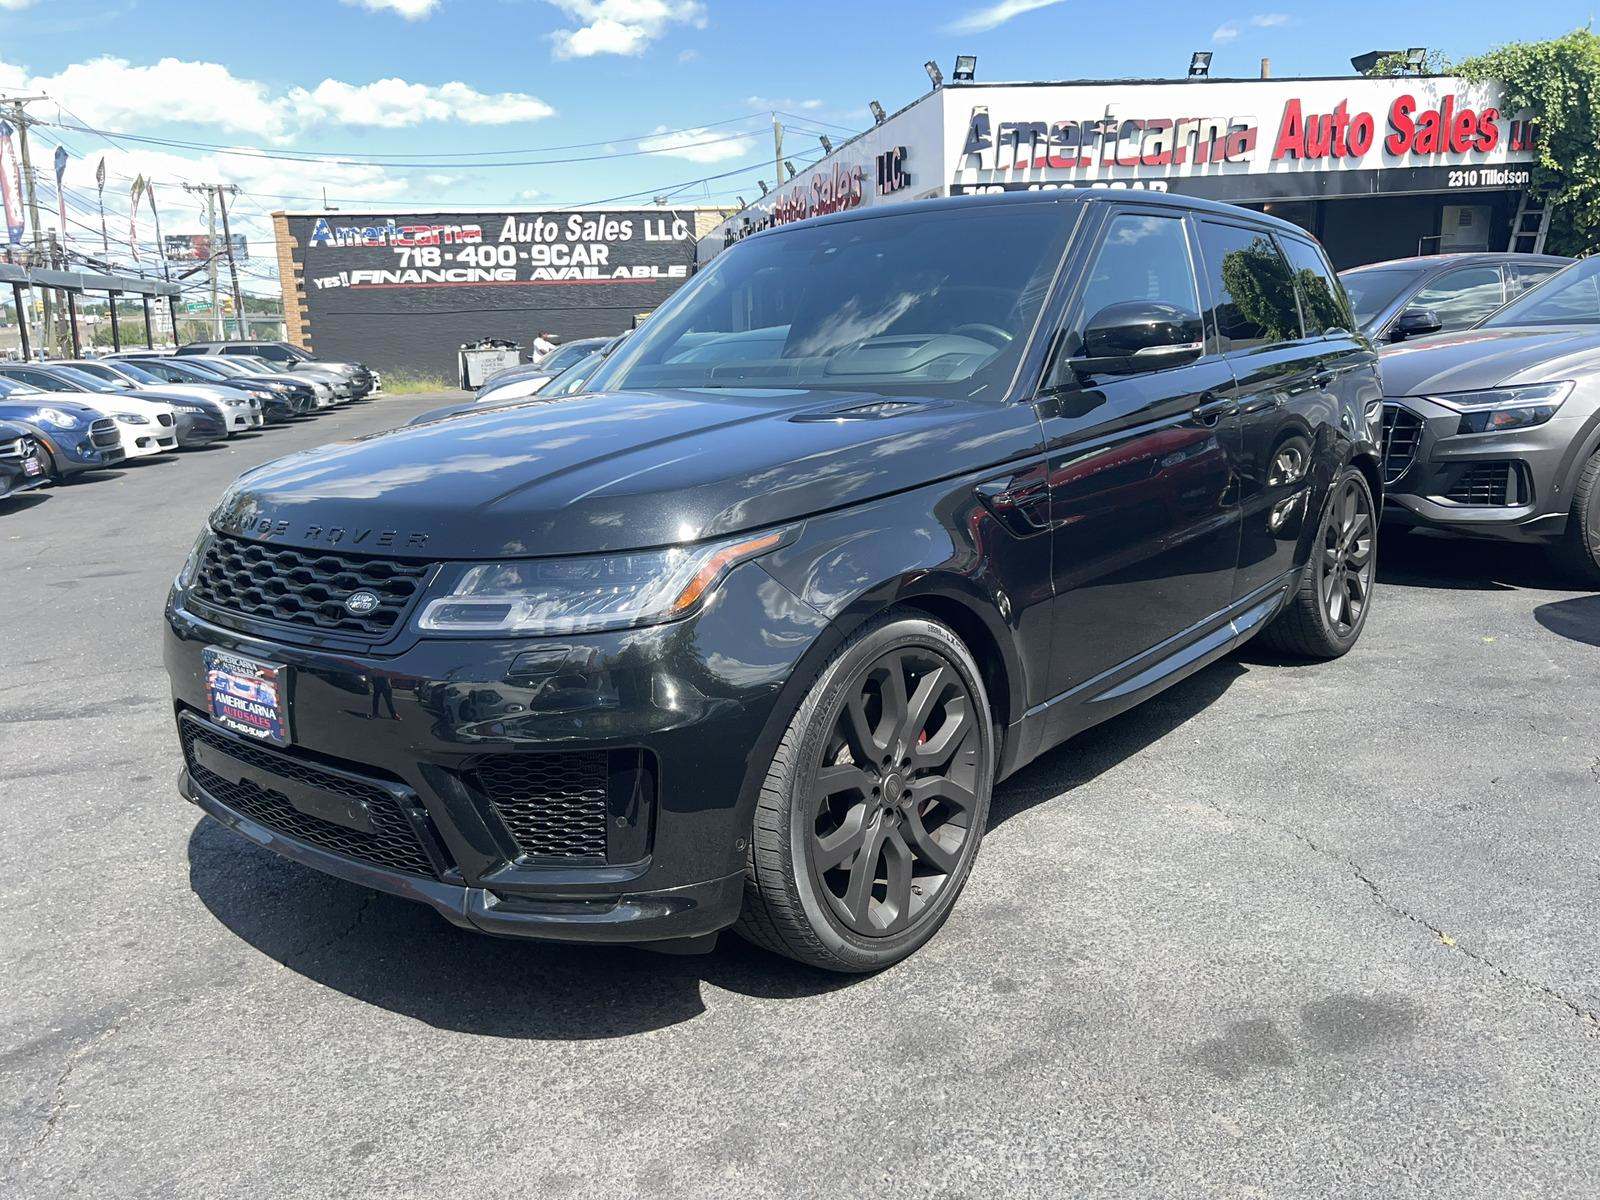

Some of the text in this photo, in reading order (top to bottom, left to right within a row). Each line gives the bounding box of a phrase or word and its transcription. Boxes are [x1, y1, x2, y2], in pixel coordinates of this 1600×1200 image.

[956, 103, 1258, 171] Americarna
[1272, 98, 1374, 160] Auto
[1385, 94, 1500, 157] Sales
[1448, 169, 1530, 187] 2310 Tillotson
[309, 214, 688, 247] Americarna Auto Sales LLC
[350, 267, 517, 285] FINANCING
[530, 265, 687, 281] AVAILABLE
[304, 525, 431, 549] ROVER
[215, 691, 277, 720] AMERICARNA
